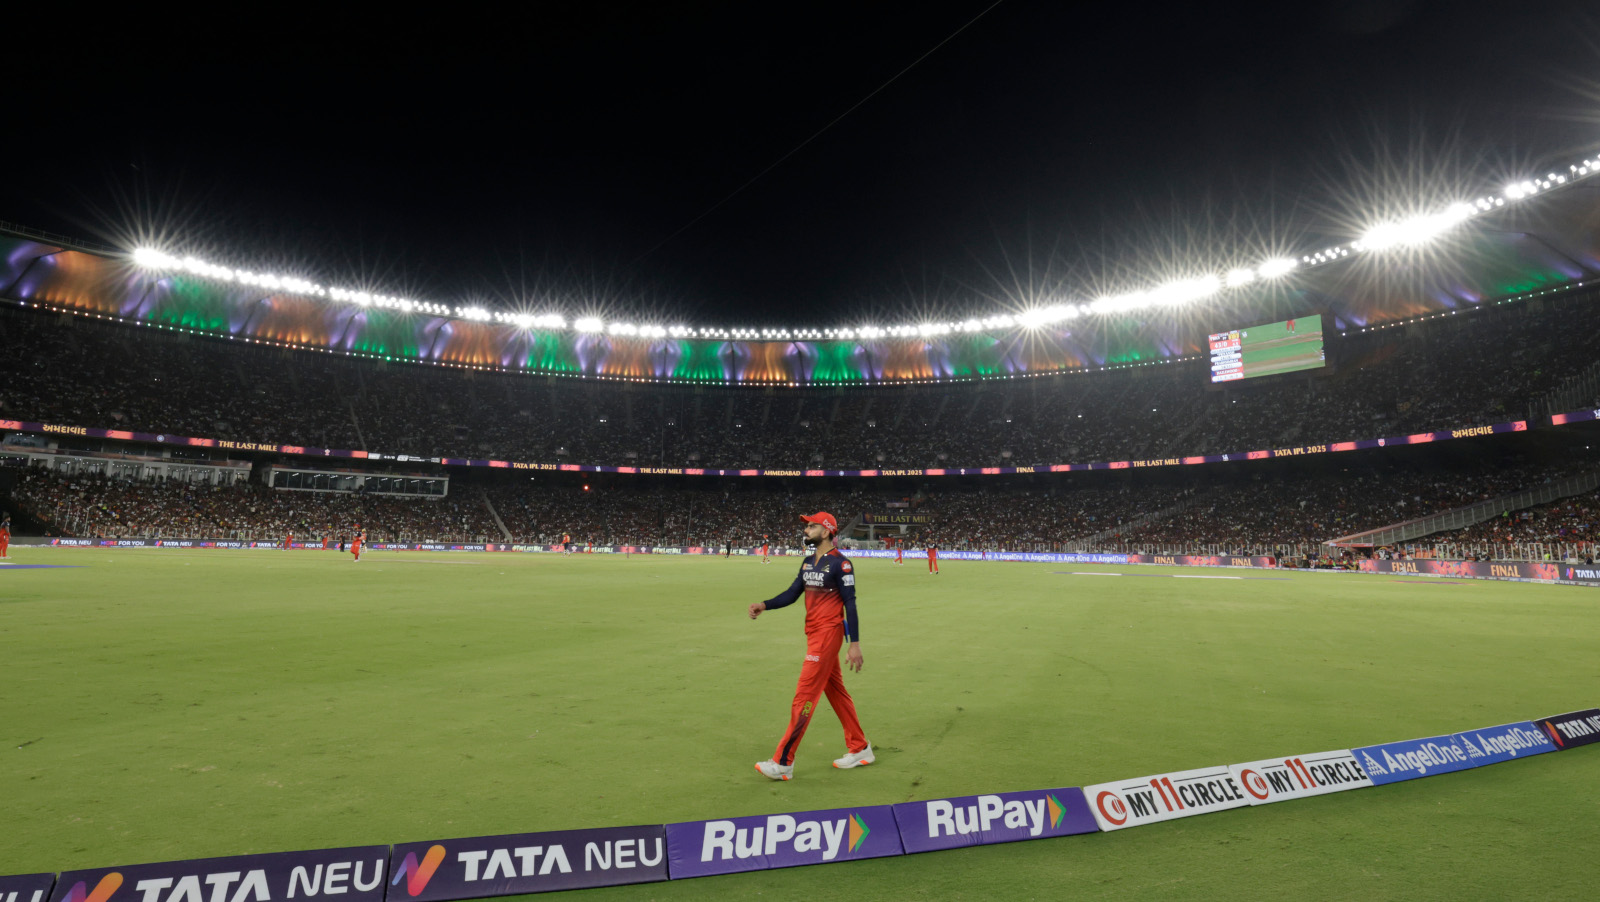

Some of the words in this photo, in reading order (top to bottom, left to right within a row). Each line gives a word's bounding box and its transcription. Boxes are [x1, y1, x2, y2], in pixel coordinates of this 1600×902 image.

[42, 424, 87, 435] અમદાવાદ
[1452, 426, 1494, 438] અમદાવાદ
[236, 442, 257, 450] LAST
[1274, 449, 1293, 457] TATA
[1307, 445, 1326, 454] 2025
[1154, 556, 1176, 565] FINAL
[1232, 558, 1253, 566] FINAL
[803, 572, 824, 581] QATAR
[1490, 565, 1520, 577] FINAL
[1575, 570, 1595, 578] TATA
[1556, 720, 1594, 738] TATA
[1476, 728, 1548, 756] AngelOne
[1382, 743, 1467, 774] AngelOne
[926, 794, 1046, 838] RuPay
[701, 814, 847, 862] RuPay
[458, 844, 572, 882] TATA
[585, 838, 662, 871] NEU
[136, 869, 270, 902] TATA
[287, 859, 383, 898] NEU
